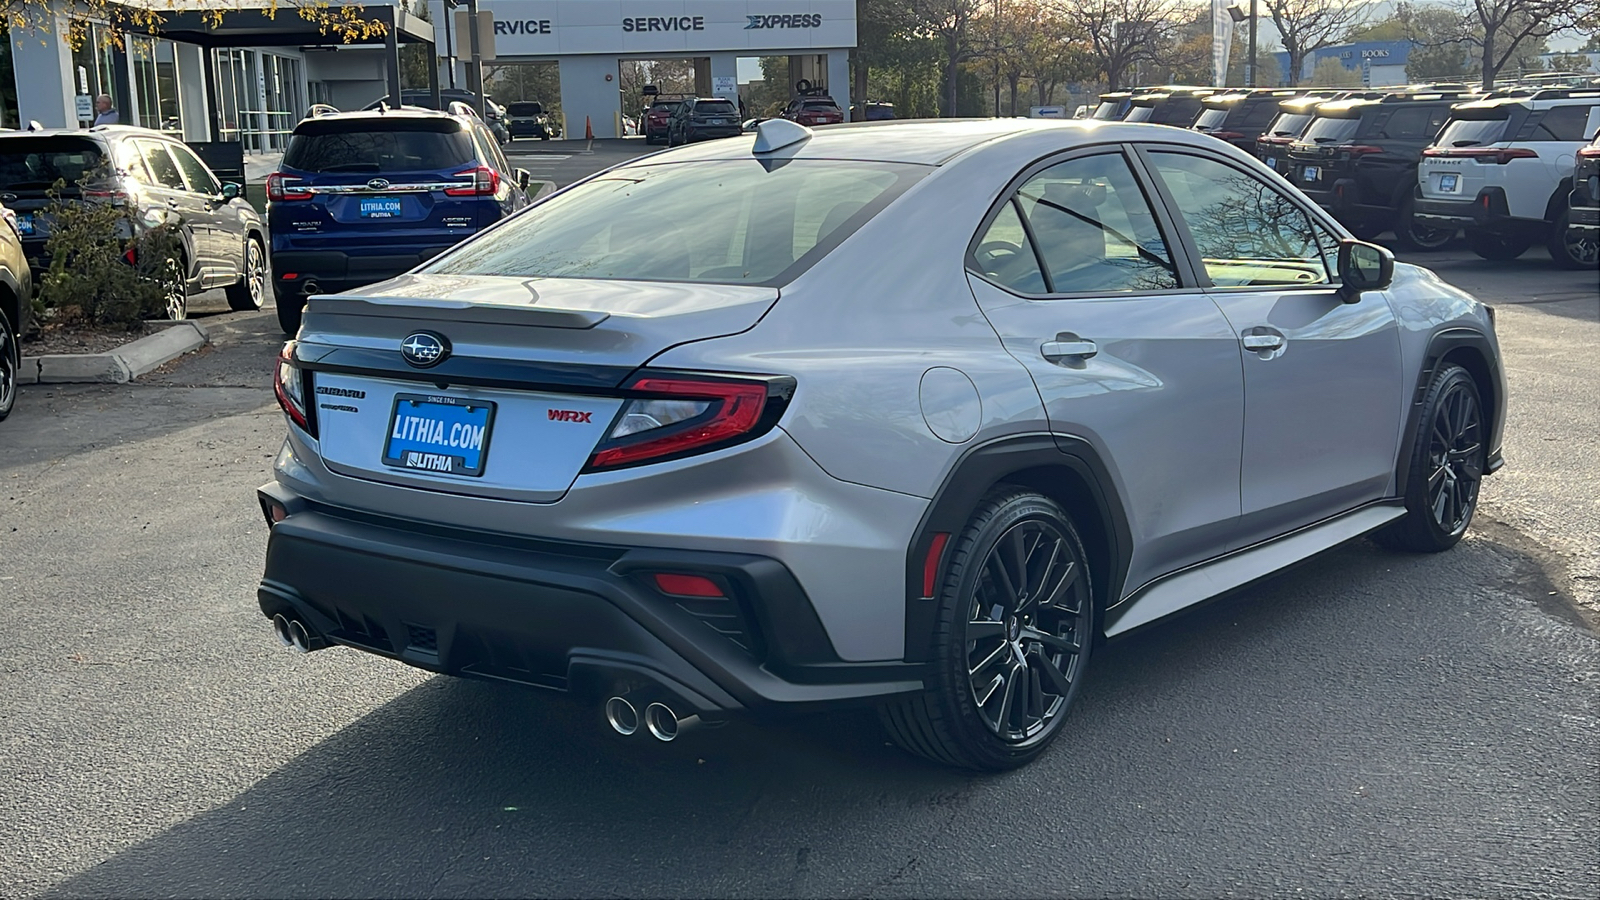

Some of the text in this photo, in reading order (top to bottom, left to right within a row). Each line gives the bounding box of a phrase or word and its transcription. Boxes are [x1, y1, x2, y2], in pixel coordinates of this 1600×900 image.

[493, 20, 551, 35] RVICE
[622, 16, 705, 32] SERVICE
[745, 14, 822, 29] EXPRESS
[1361, 50, 1389, 58] BOOKS
[361, 202, 400, 211] LITHIA.COM
[316, 386, 366, 399] SUBARU
[427, 396, 443, 404] SINCE
[548, 409, 592, 423] WRX
[392, 414, 485, 451] LITHIA.COM
[416, 453, 452, 472] LITHIA
